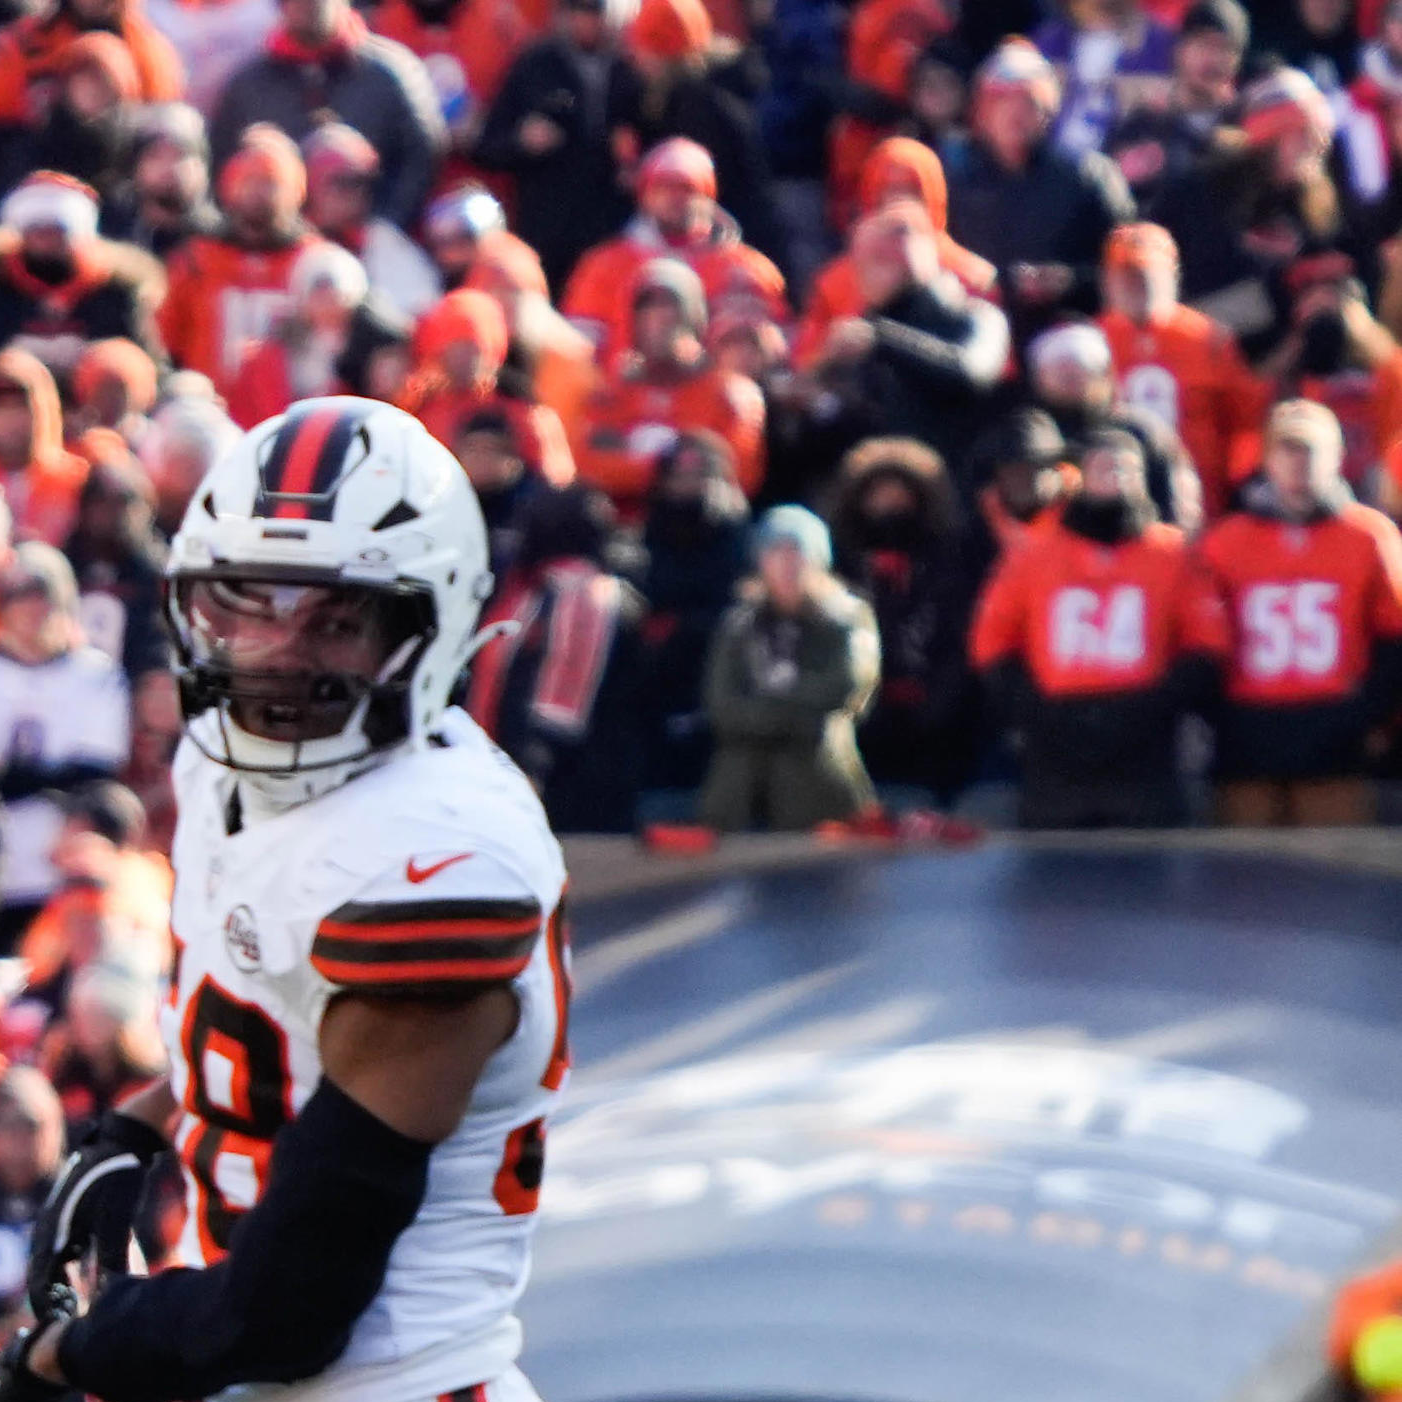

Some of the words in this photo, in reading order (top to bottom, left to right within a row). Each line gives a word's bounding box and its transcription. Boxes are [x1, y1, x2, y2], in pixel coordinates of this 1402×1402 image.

[1051, 584, 1145, 668] 64
[1246, 579, 1341, 680] 55
[168, 932, 296, 1268] 8
